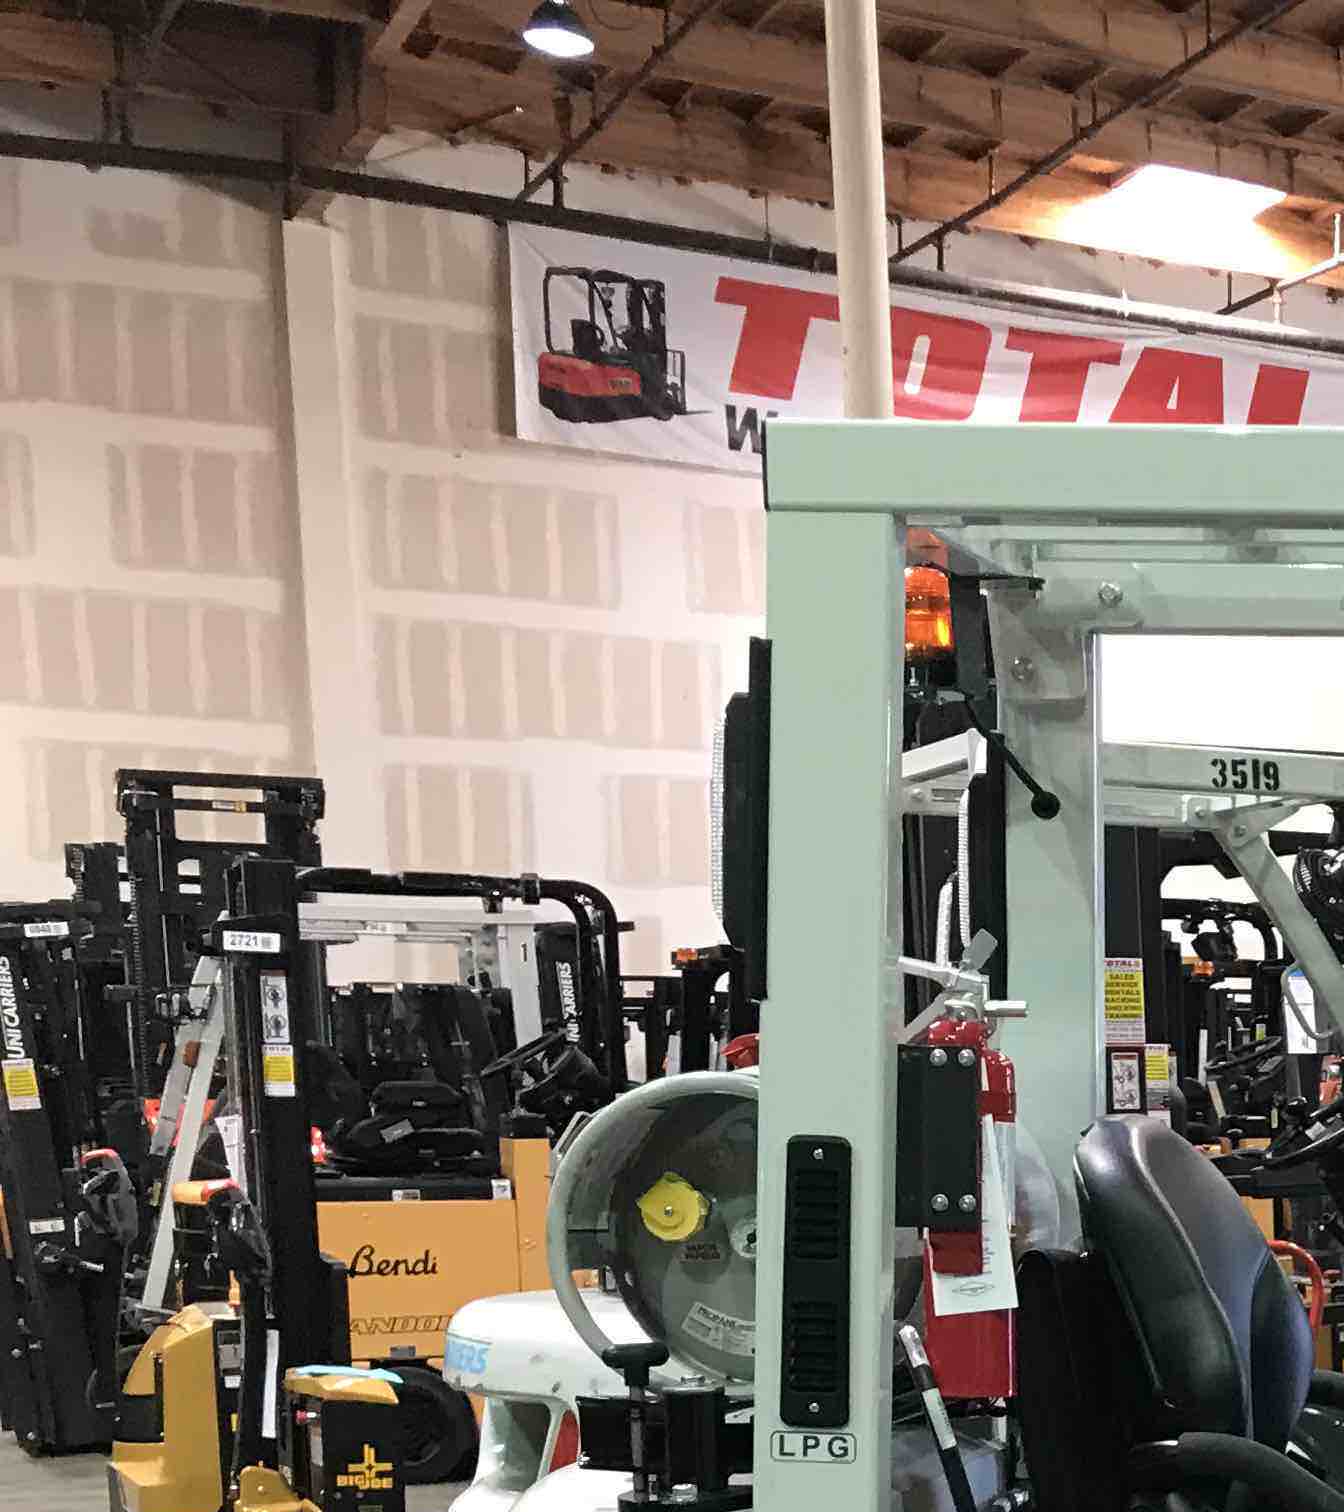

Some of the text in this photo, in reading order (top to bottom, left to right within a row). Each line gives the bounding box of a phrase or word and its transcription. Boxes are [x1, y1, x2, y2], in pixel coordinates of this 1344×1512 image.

[1211, 759, 1280, 790] 3519
[229, 934, 259, 946] 2721
[555, 961, 581, 1043] NIARRIERS
[347, 1244, 439, 1277] Bendi
[778, 1434, 849, 1458] LPG
